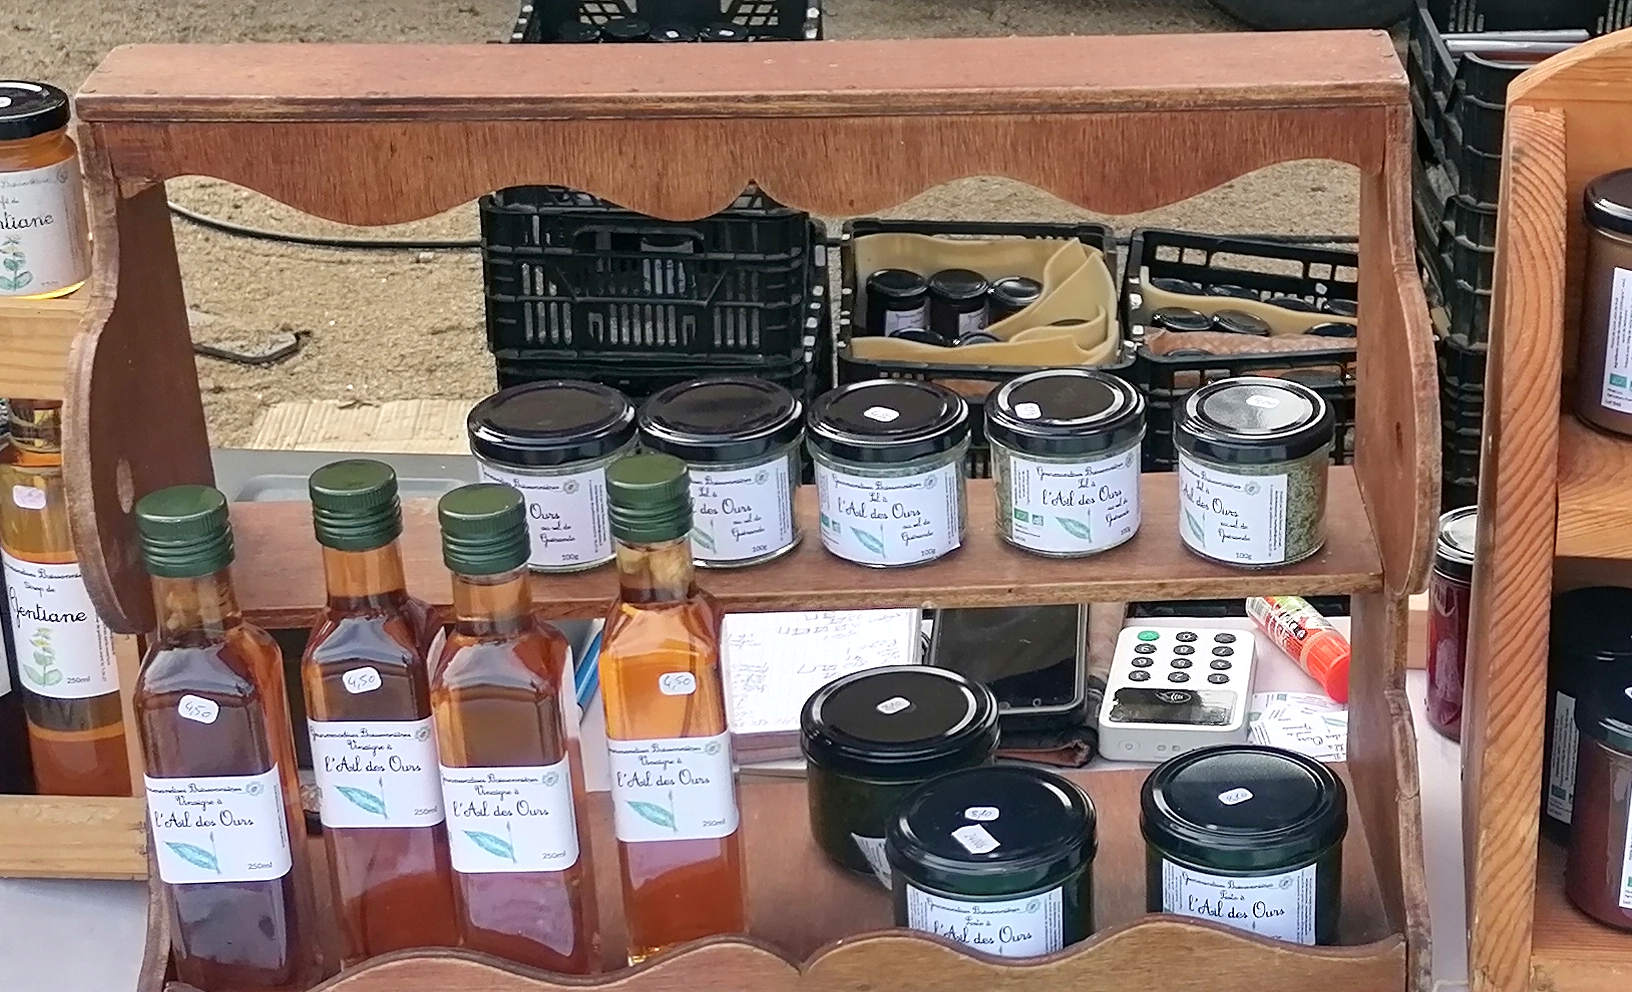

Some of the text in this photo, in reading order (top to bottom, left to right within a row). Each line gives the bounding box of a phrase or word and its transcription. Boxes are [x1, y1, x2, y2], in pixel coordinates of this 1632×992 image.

[1099, 484, 1122, 502] Ours
[529, 502, 561, 521] Ours
[721, 497, 752, 515] Ours
[892, 502, 921, 519] Ours
[9, 586, 88, 628] Gentiane
[347, 674, 376, 689] 4,50
[365, 760, 385, 772] des
[389, 755, 422, 772] Ours
[656, 776, 675, 786] des
[678, 768, 710, 785] Ours
[493, 805, 513, 816] des
[517, 799, 549, 817] Ours
[195, 814, 216, 827] des
[219, 809, 254, 827] Ours
[1227, 906, 1248, 919] des
[1252, 900, 1285, 919] Ours
[973, 933, 994, 944] des
[999, 925, 1032, 943] Ours
